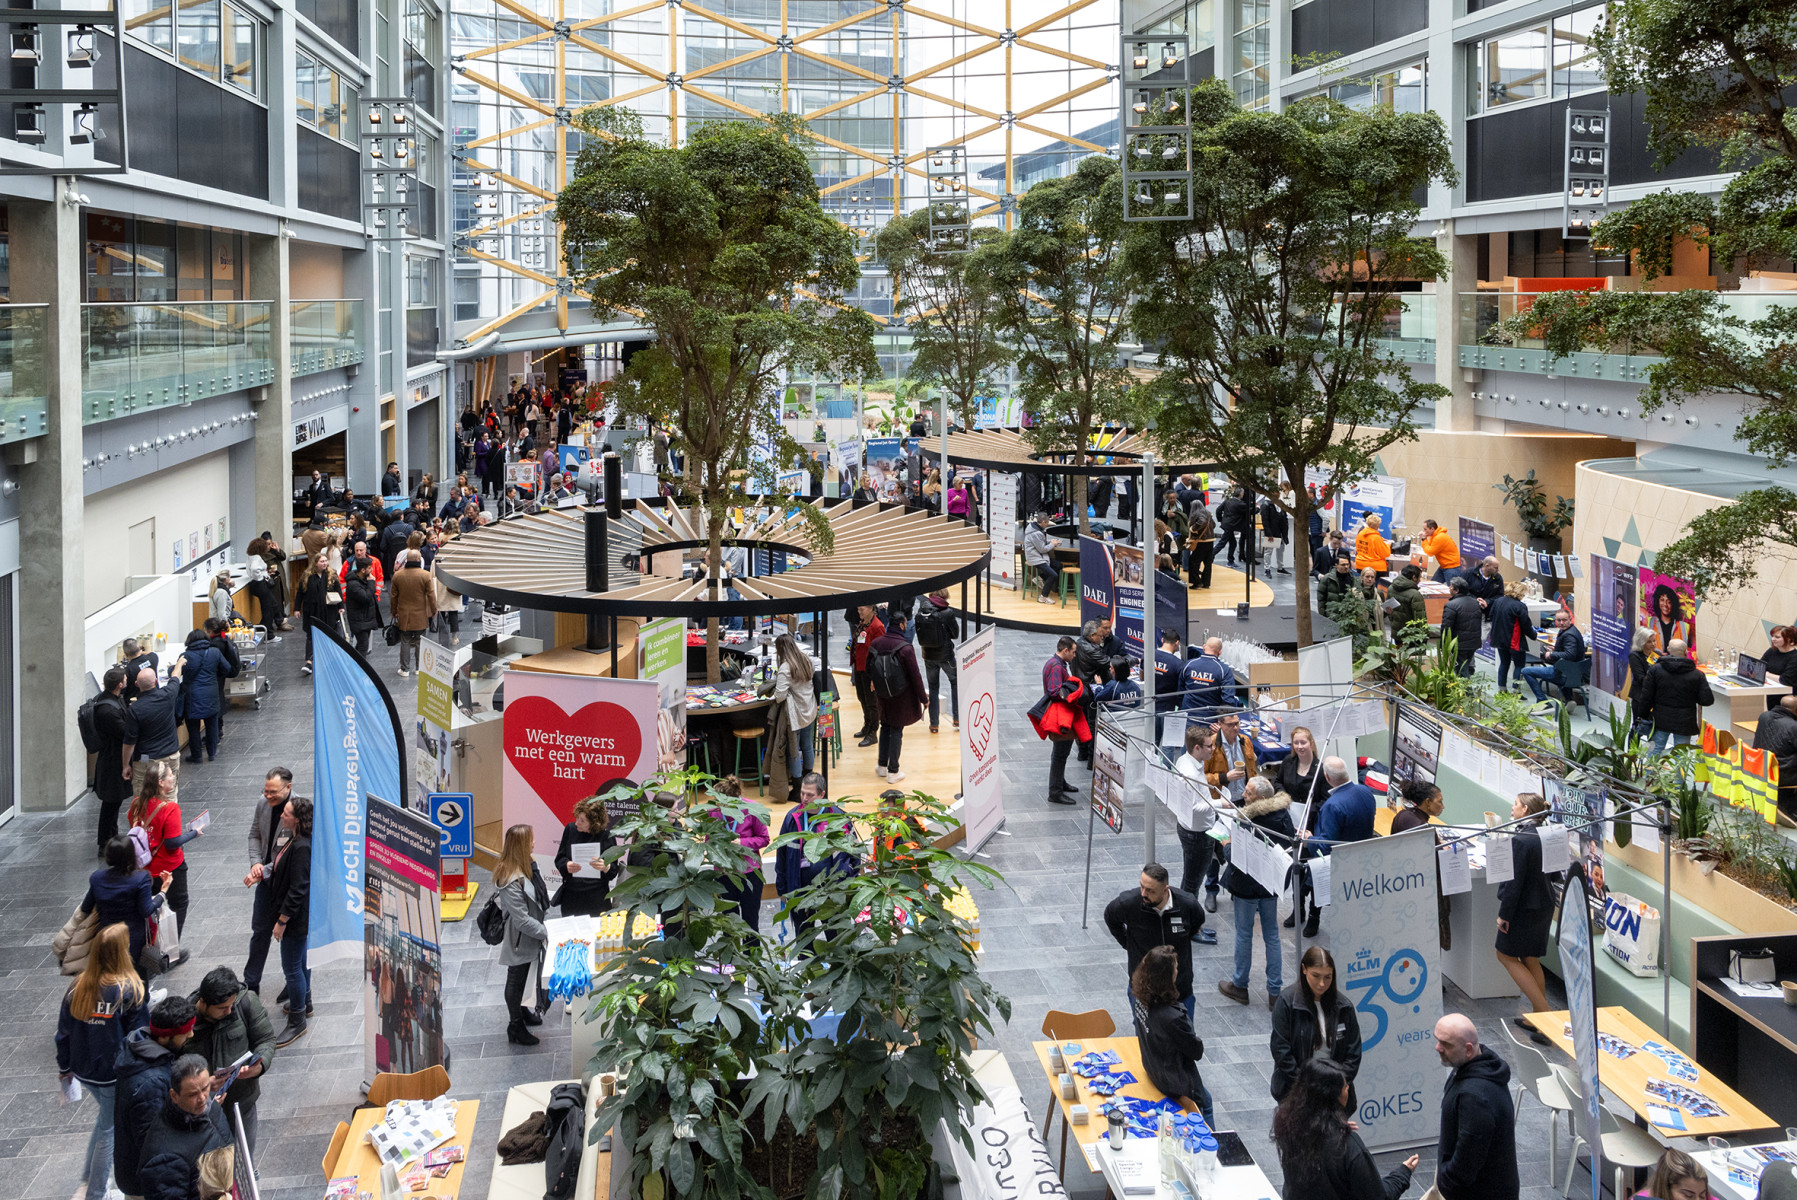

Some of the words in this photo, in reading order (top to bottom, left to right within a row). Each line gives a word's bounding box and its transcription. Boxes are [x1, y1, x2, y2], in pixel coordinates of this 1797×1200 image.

[308, 416, 326, 439] VIVA
[1623, 573, 1634, 581] WFS
[1083, 584, 1109, 606] DAEL
[1120, 588, 1131, 597] FIELD
[1131, 589, 1144, 597] SERV
[648, 642, 652, 650] Ik
[653, 632, 680, 648] combineer
[648, 651, 661, 662] leren
[662, 648, 668, 656] en
[648, 659, 667, 673] werken
[1155, 661, 1169, 672] AEL
[1190, 670, 1215, 681] DAEL
[427, 680, 448, 703] SAMEN
[1120, 691, 1139, 700] DAEL
[525, 728, 615, 750] Werkgevers
[515, 746, 544, 760] met
[548, 750, 576, 763] een
[580, 752, 626, 767] warm
[553, 763, 585, 780] hart
[1562, 787, 1586, 805] JOIN
[616, 801, 640, 810] talente
[1565, 800, 1589, 816] OUR
[370, 809, 383, 821] Geeft
[398, 824, 423, 843] voldoening
[370, 827, 386, 841] helpen?
[386, 827, 400, 840] gerust
[401, 833, 409, 843] kan
[410, 839, 425, 852] stellen
[426, 847, 432, 856] en
[448, 844, 468, 853] VRIJ
[369, 863, 390, 880] Hospitality
[409, 860, 436, 881] NEDERLANDS
[1343, 872, 1425, 901] Welkom
[1347, 958, 1380, 974] KLM
[97, 1001, 115, 1015] EL
[1397, 1029, 1431, 1047] years
[1360, 1091, 1423, 1126] @KES
